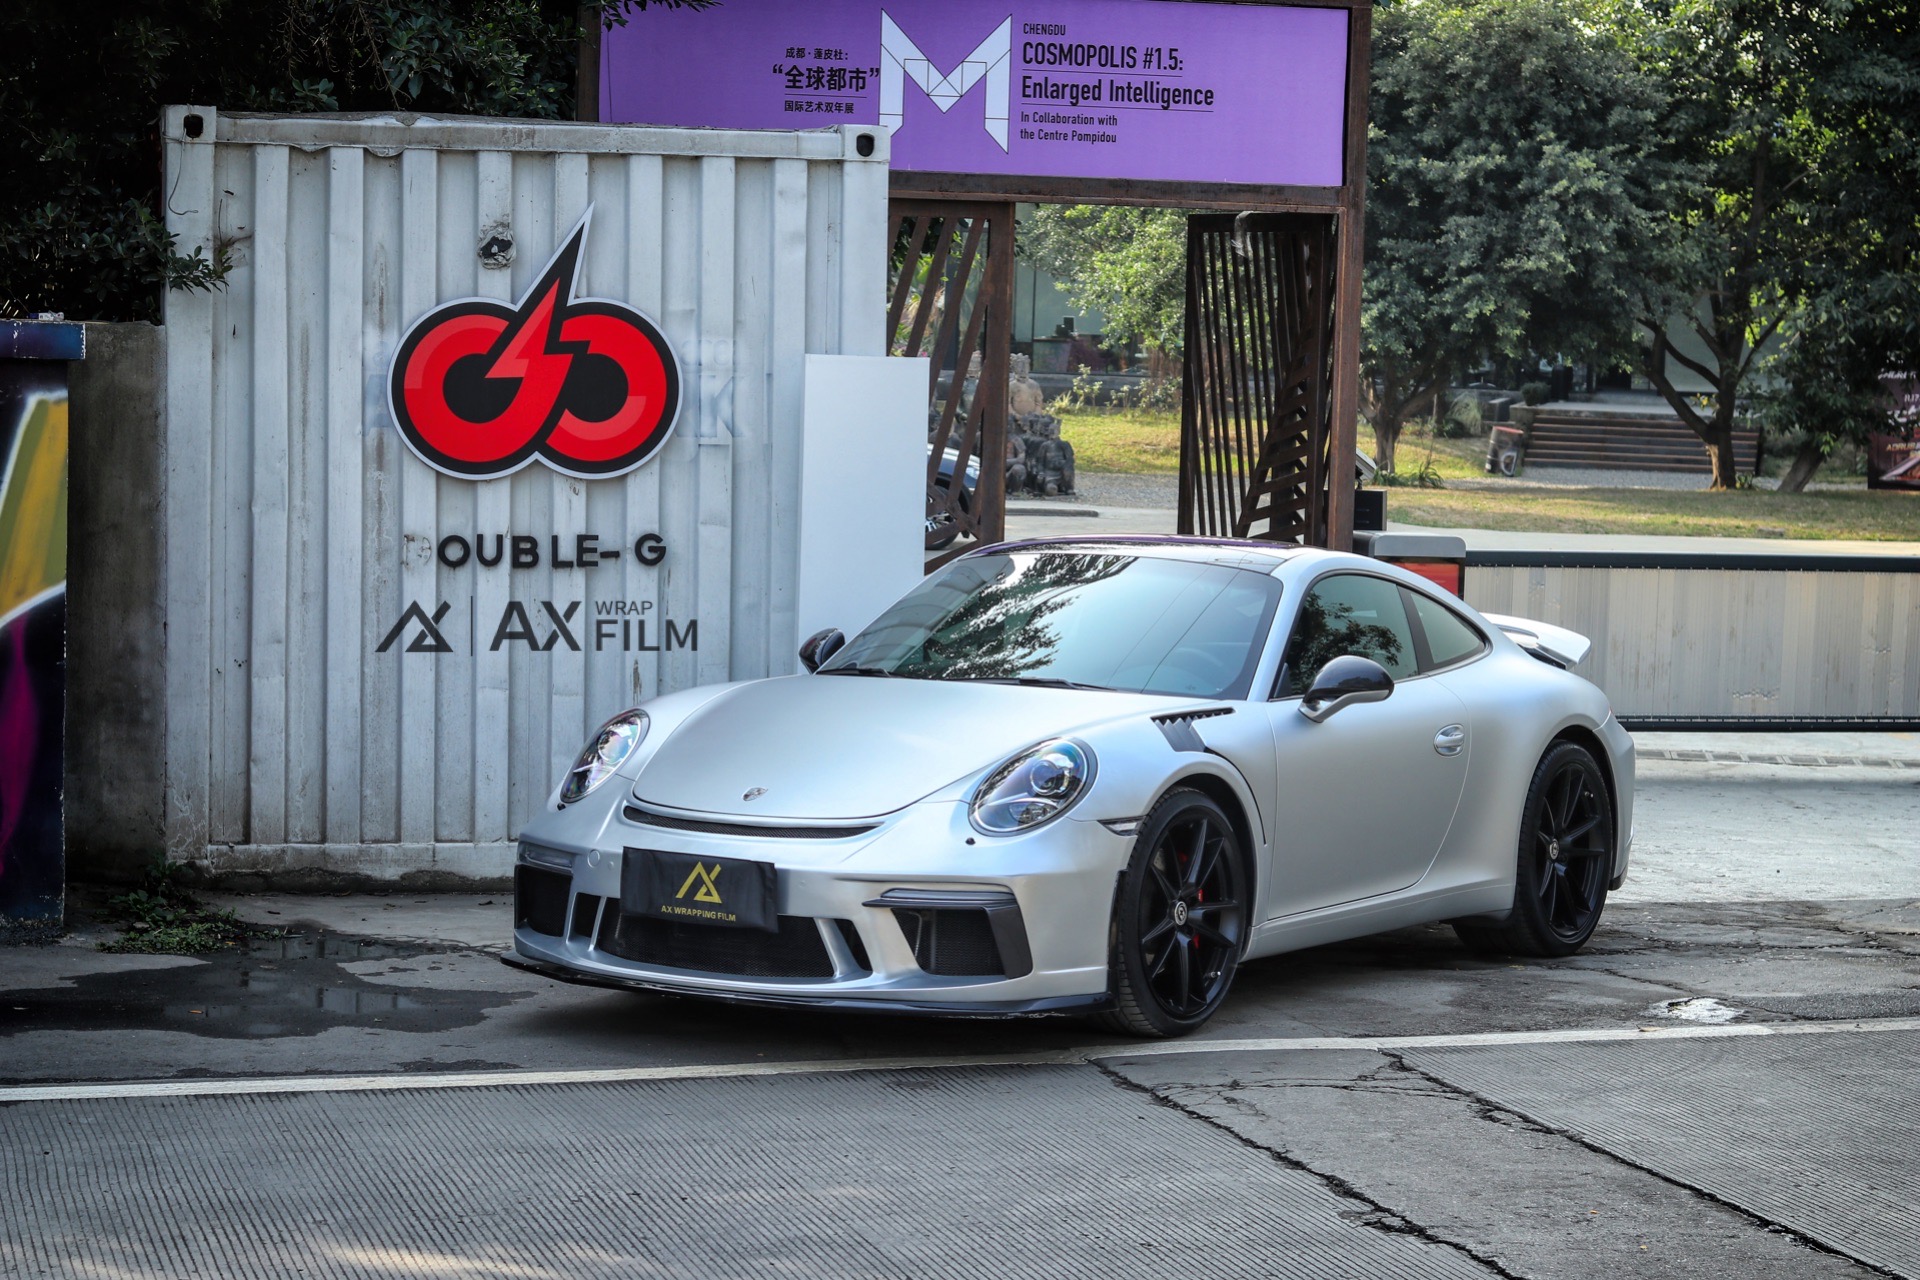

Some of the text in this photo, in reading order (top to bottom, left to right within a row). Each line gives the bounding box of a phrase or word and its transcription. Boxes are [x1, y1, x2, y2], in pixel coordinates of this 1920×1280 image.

[1023, 23, 1066, 36] CHENGDU
[1022, 41, 1184, 71] COSMOPOLIS #1.5:
[1021, 76, 1215, 110] Enlarged Intelligence
[784, 100, 855, 114] 国际艺术双年展
[1020, 111, 1118, 126] In Collaboration with
[1020, 129, 1117, 145] the Centre Pompidou
[400, 533, 667, 569] OUBLE-G
[489, 600, 653, 652] AX WRAP
[595, 619, 698, 652] FILM
[661, 905, 737, 922] AX WRAPPING FILM
